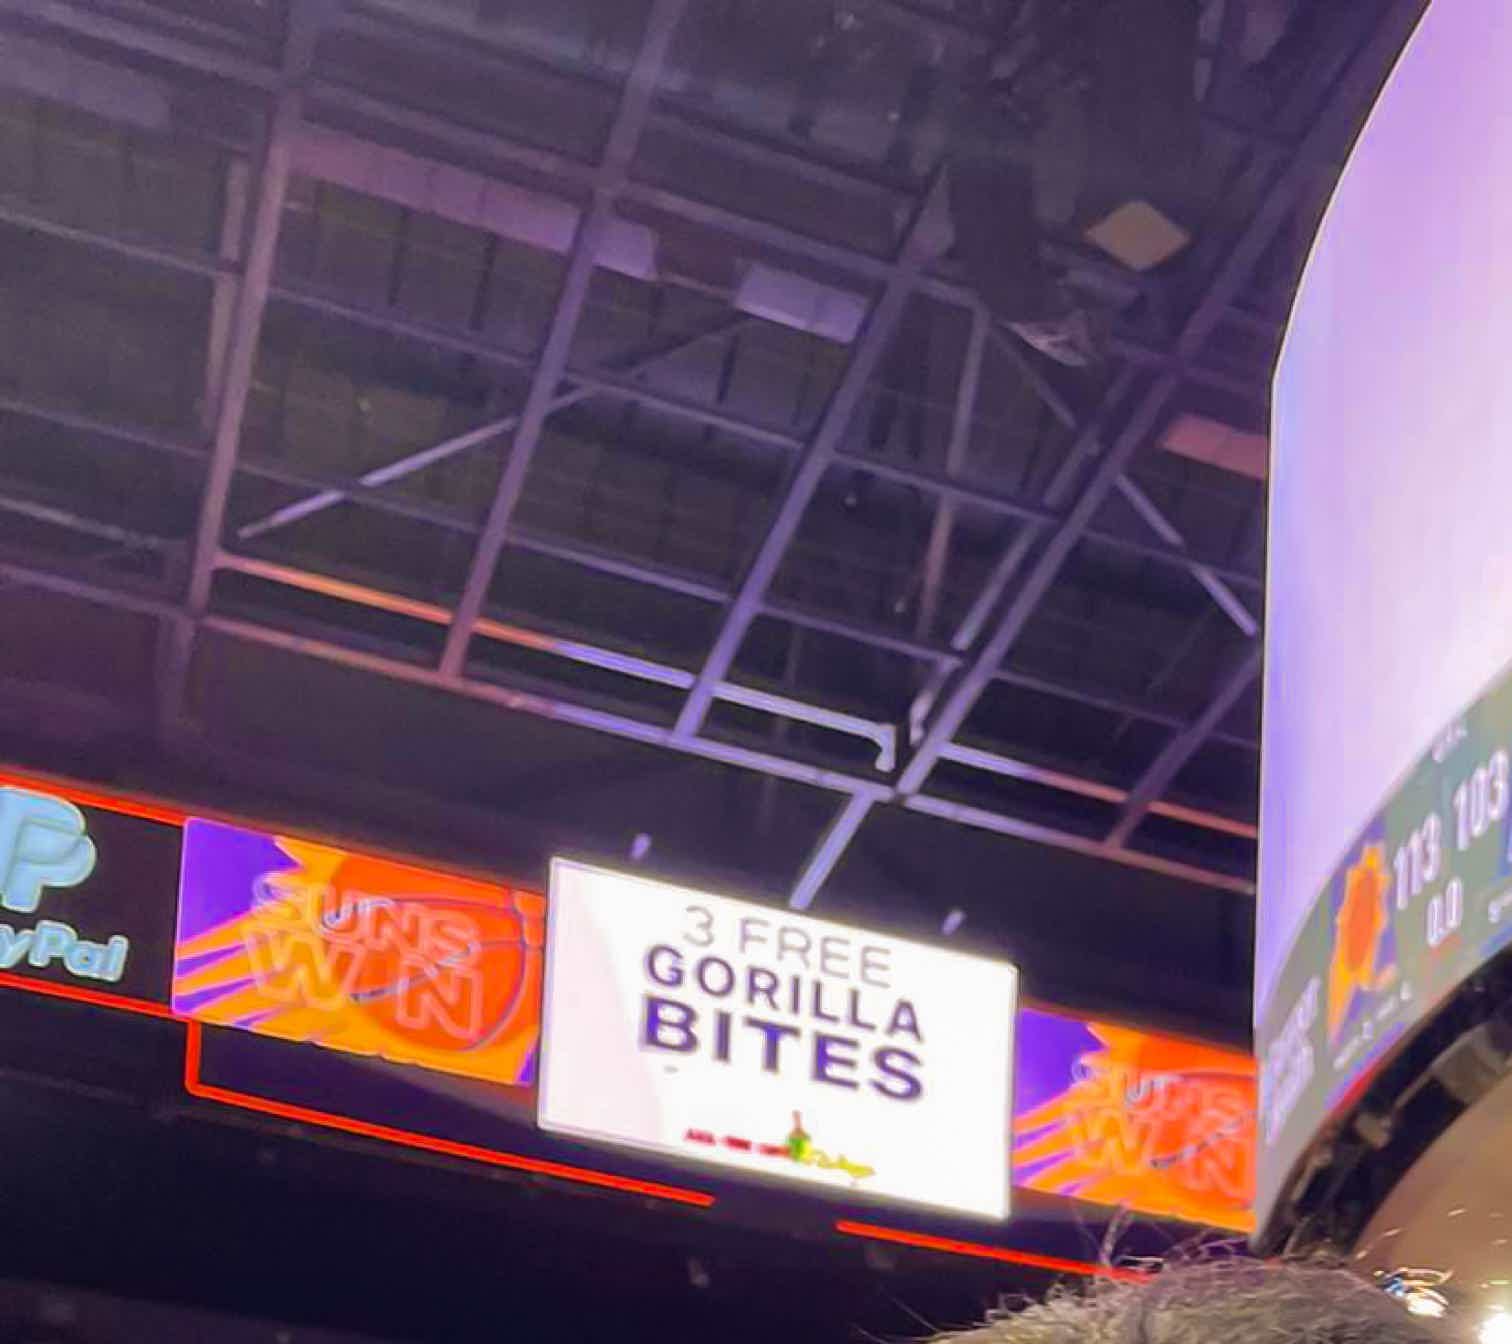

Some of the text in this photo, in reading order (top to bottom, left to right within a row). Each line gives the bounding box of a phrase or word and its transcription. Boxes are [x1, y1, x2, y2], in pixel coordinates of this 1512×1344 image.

[642, 942, 925, 1044] GORILLA
[682, 904, 893, 990] 3 FREE
[638, 992, 926, 1103] BITES
